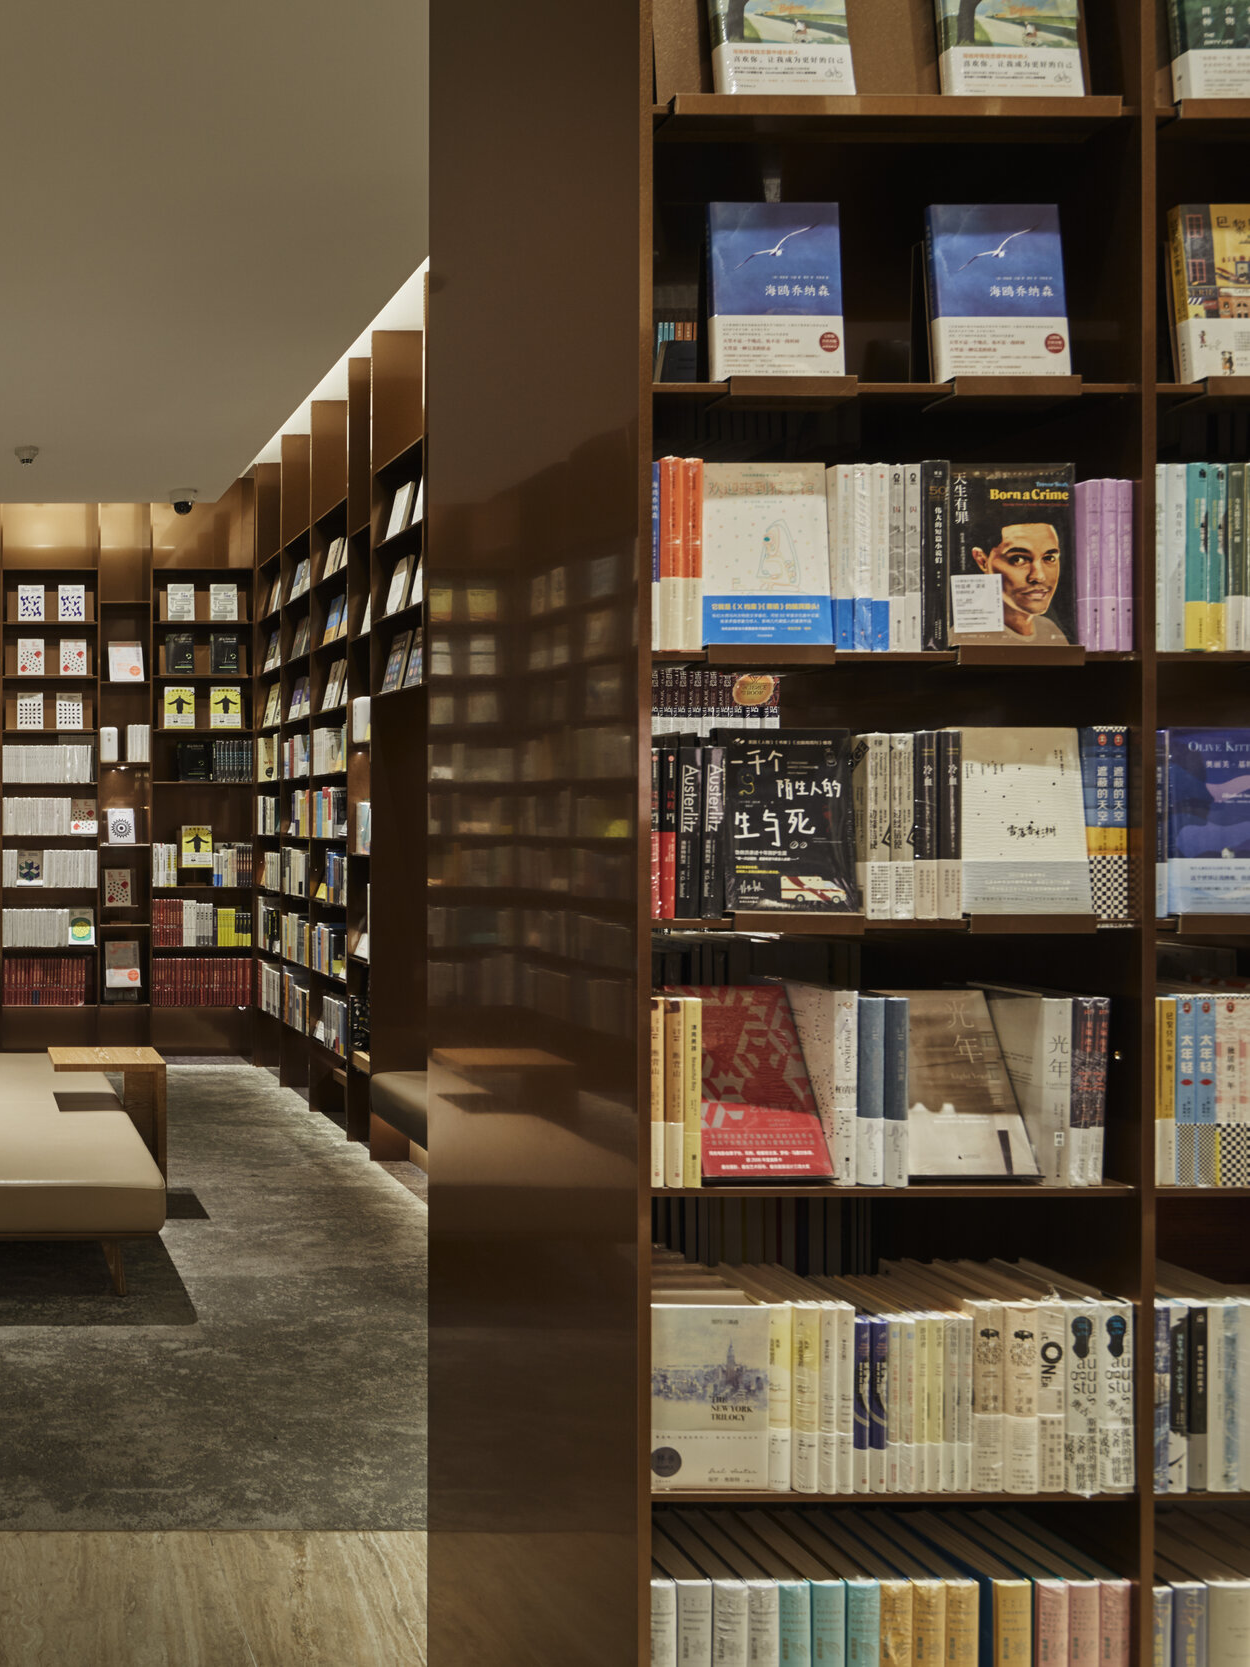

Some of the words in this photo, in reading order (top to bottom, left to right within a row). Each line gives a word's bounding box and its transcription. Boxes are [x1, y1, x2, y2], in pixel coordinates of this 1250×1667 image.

[764, 284, 830, 298] 海鸥乔纳森
[988, 285, 1054, 298] 海鸥乔纳森
[953, 472, 969, 524] 天生有罪
[989, 488, 1021, 501] Born
[1031, 488, 1069, 501] Crime
[730, 749, 783, 775] 一千个
[1225, 741, 1250, 752] KITT
[681, 764, 700, 833] Austerlitz
[705, 763, 724, 833] Austerlitz
[776, 778, 842, 800] 陌生人的
[1097, 766, 1108, 822] 遮蔽的天空
[1113, 766, 1125, 822] 遮蔽的天空
[734, 809, 816, 847] 生与死
[1048, 1035, 1069, 1079] 光年
[1180, 1035, 1194, 1074] 太年轻
[1200, 1035, 1213, 1074] 太年轻
[711, 1405, 730, 1413] NEW
[730, 1405, 753, 1413] YORK
[711, 1413, 746, 1422] TRILOGY
